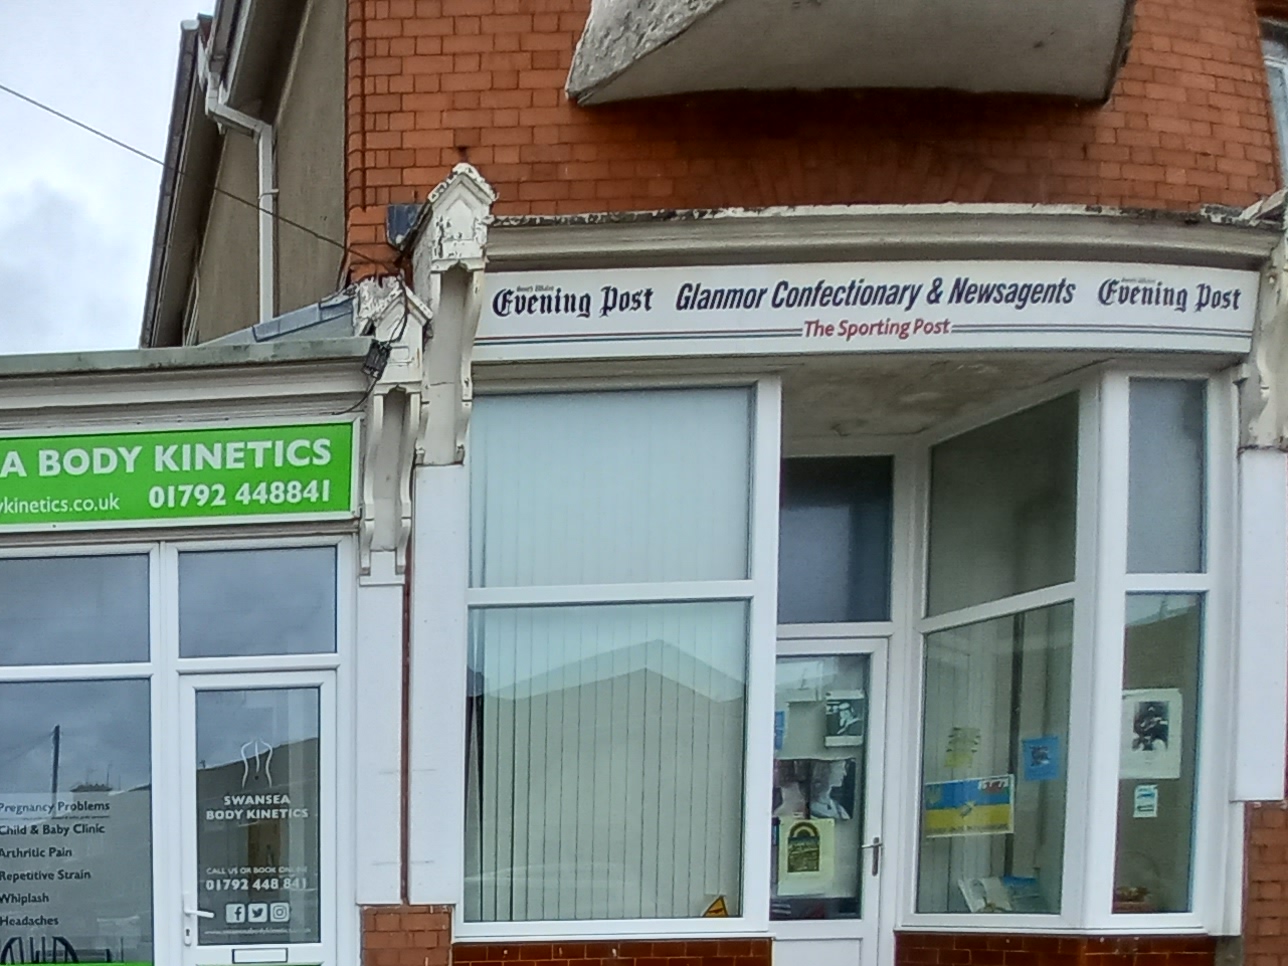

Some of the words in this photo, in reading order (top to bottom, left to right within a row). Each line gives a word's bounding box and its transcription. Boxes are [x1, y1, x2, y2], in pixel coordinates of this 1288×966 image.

[676, 282, 768, 311] Glanmor
[771, 278, 923, 312] Confectionary
[926, 277, 944, 304] &
[947, 277, 1076, 310] Newsagents
[1098, 278, 1188, 313] Evening
[1194, 283, 1242, 313] Post
[492, 287, 591, 318] Evening
[600, 285, 654, 318] Post
[804, 320, 835, 337] The
[837, 318, 911, 341] Sporting
[913, 318, 951, 335] Post
[38, 446, 142, 476] BODY
[155, 438, 332, 472] KINETICS
[149, 483, 227, 509] 01792
[235, 480, 330, 505] 448841
[57, 801, 110, 812] Problems
[223, 794, 291, 806] SWANSEA
[206, 809, 243, 821] BODY
[246, 808, 309, 820] KINETICS
[30, 824, 39, 834] &
[42, 824, 70, 836] Baby
[73, 823, 106, 834] Clinic
[49, 847, 73, 858] Pain
[57, 869, 91, 880] Strain
[206, 878, 249, 891] 01792
[252, 878, 279, 890] 448
[283, 878, 307, 890] 841
[0, 915, 59, 926] Headaches
